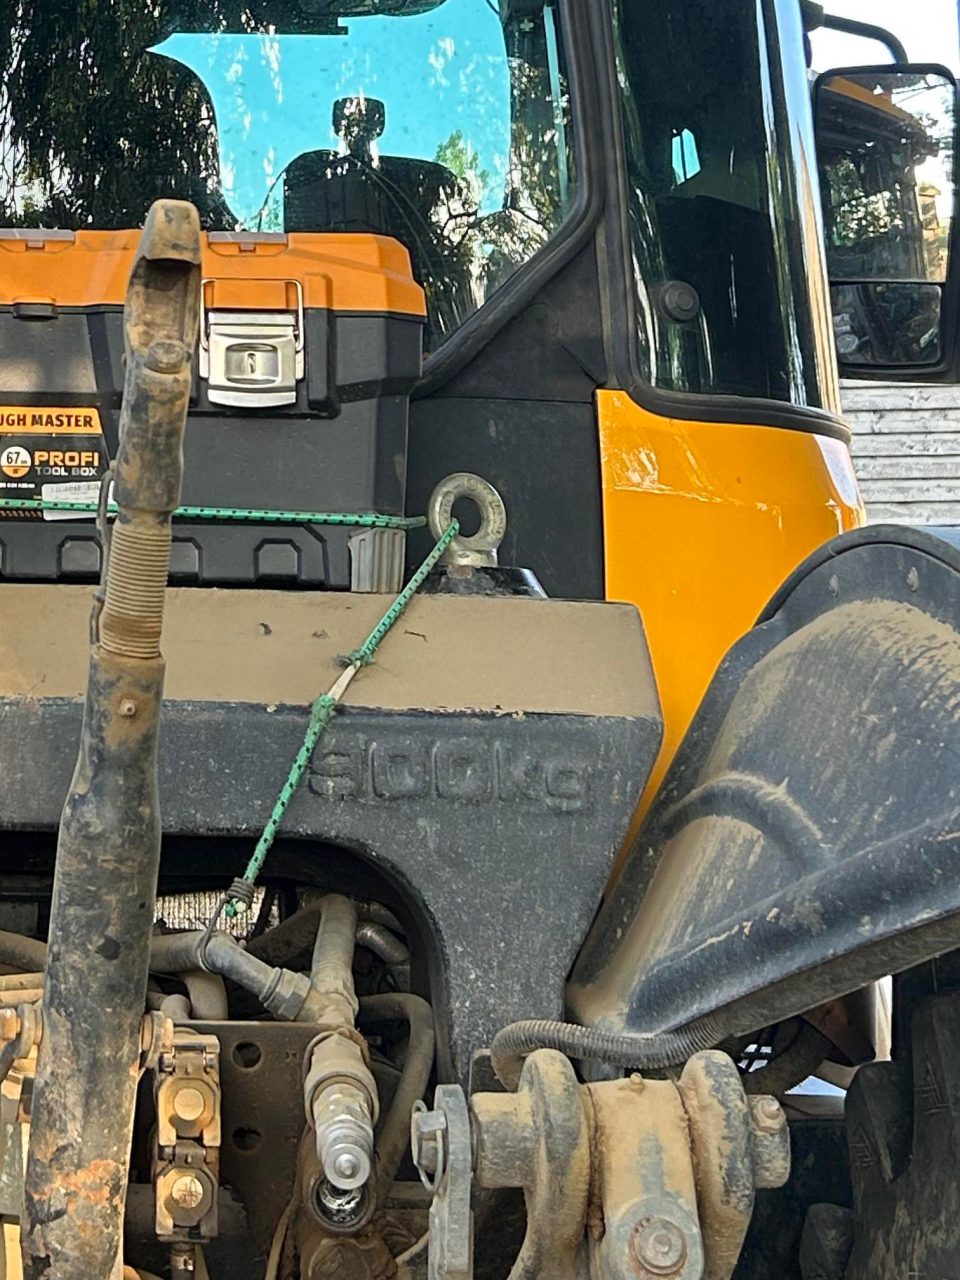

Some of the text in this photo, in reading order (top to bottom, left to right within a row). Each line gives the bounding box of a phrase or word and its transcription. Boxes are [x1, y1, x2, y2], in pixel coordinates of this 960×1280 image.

[31, 414, 94, 428] MASTER
[34, 451, 100, 467] PROFI
[35, 467, 98, 476] TOOL BOX
